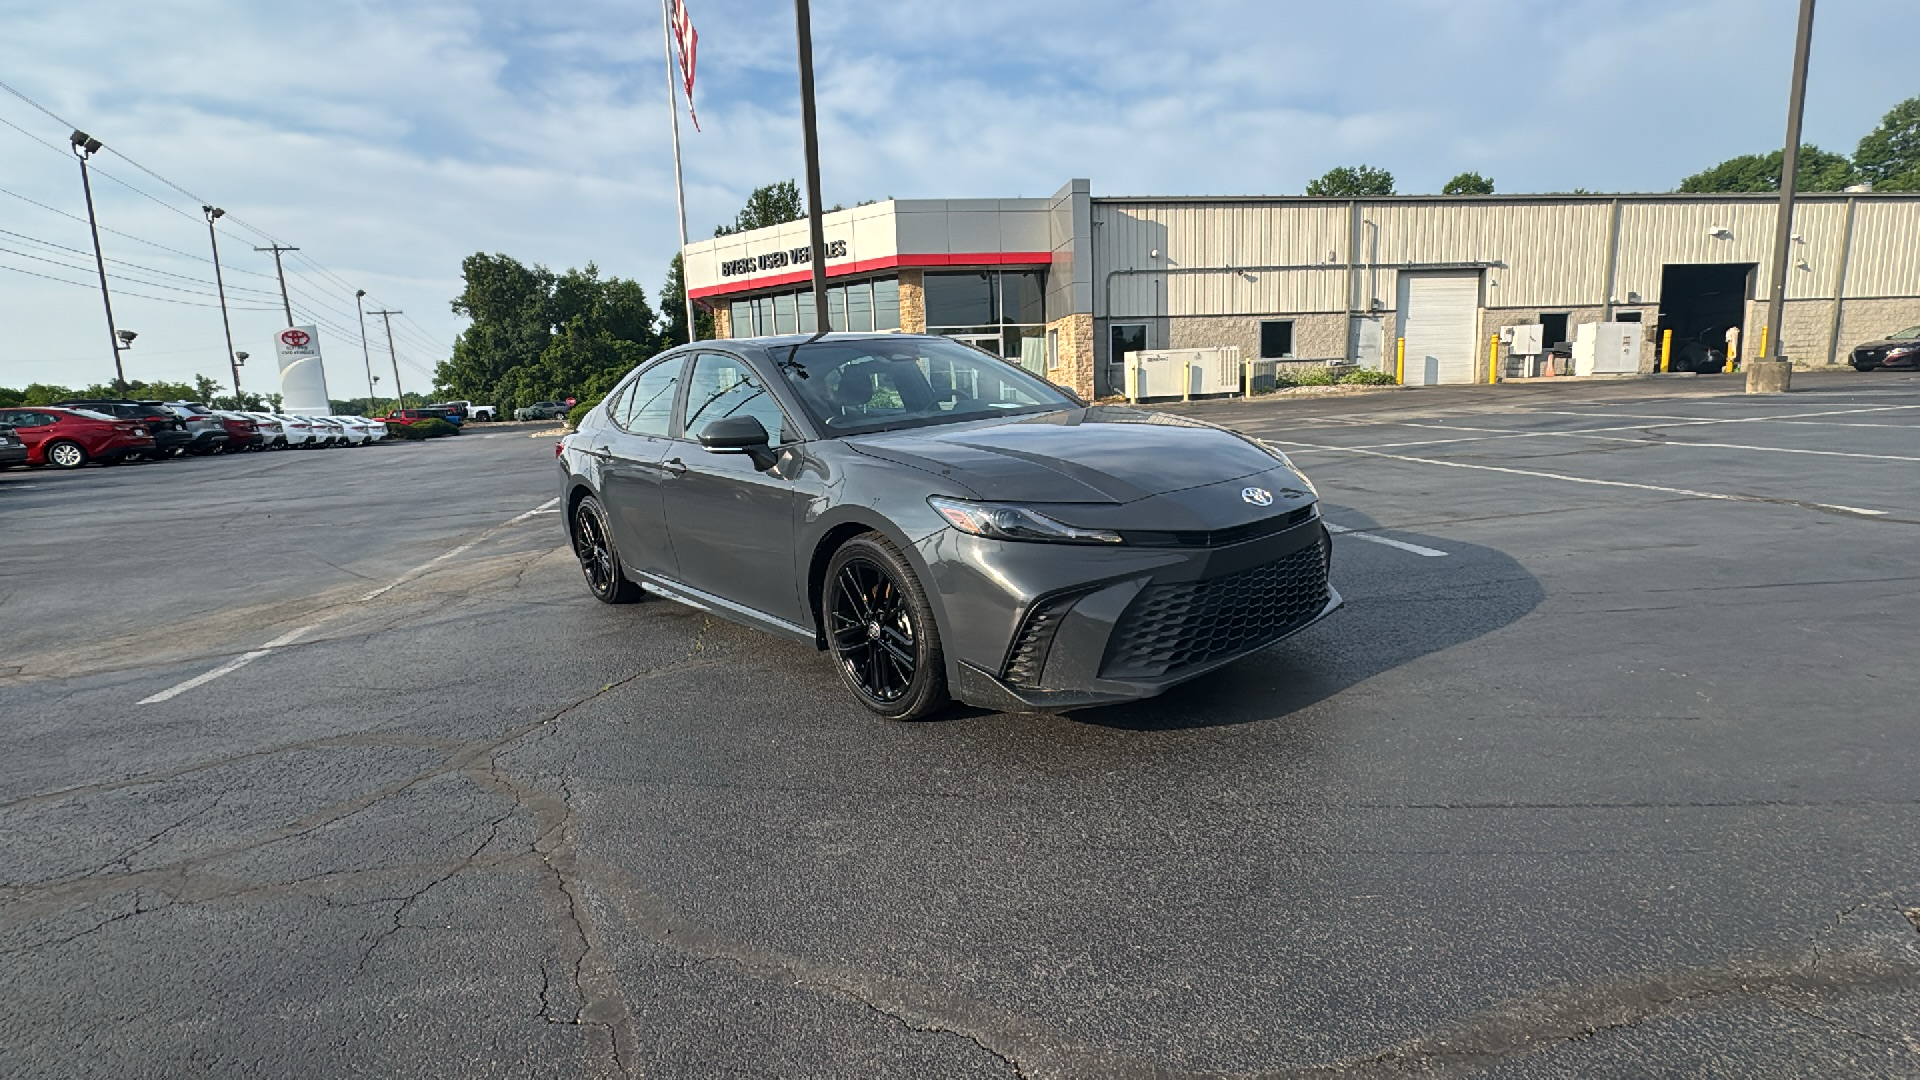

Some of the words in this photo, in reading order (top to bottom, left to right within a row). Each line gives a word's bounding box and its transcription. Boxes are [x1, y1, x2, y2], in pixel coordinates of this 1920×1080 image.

[722, 257, 757, 276] BYERS
[758, 252, 788, 270] USED
[789, 240, 846, 264] VEHLES
